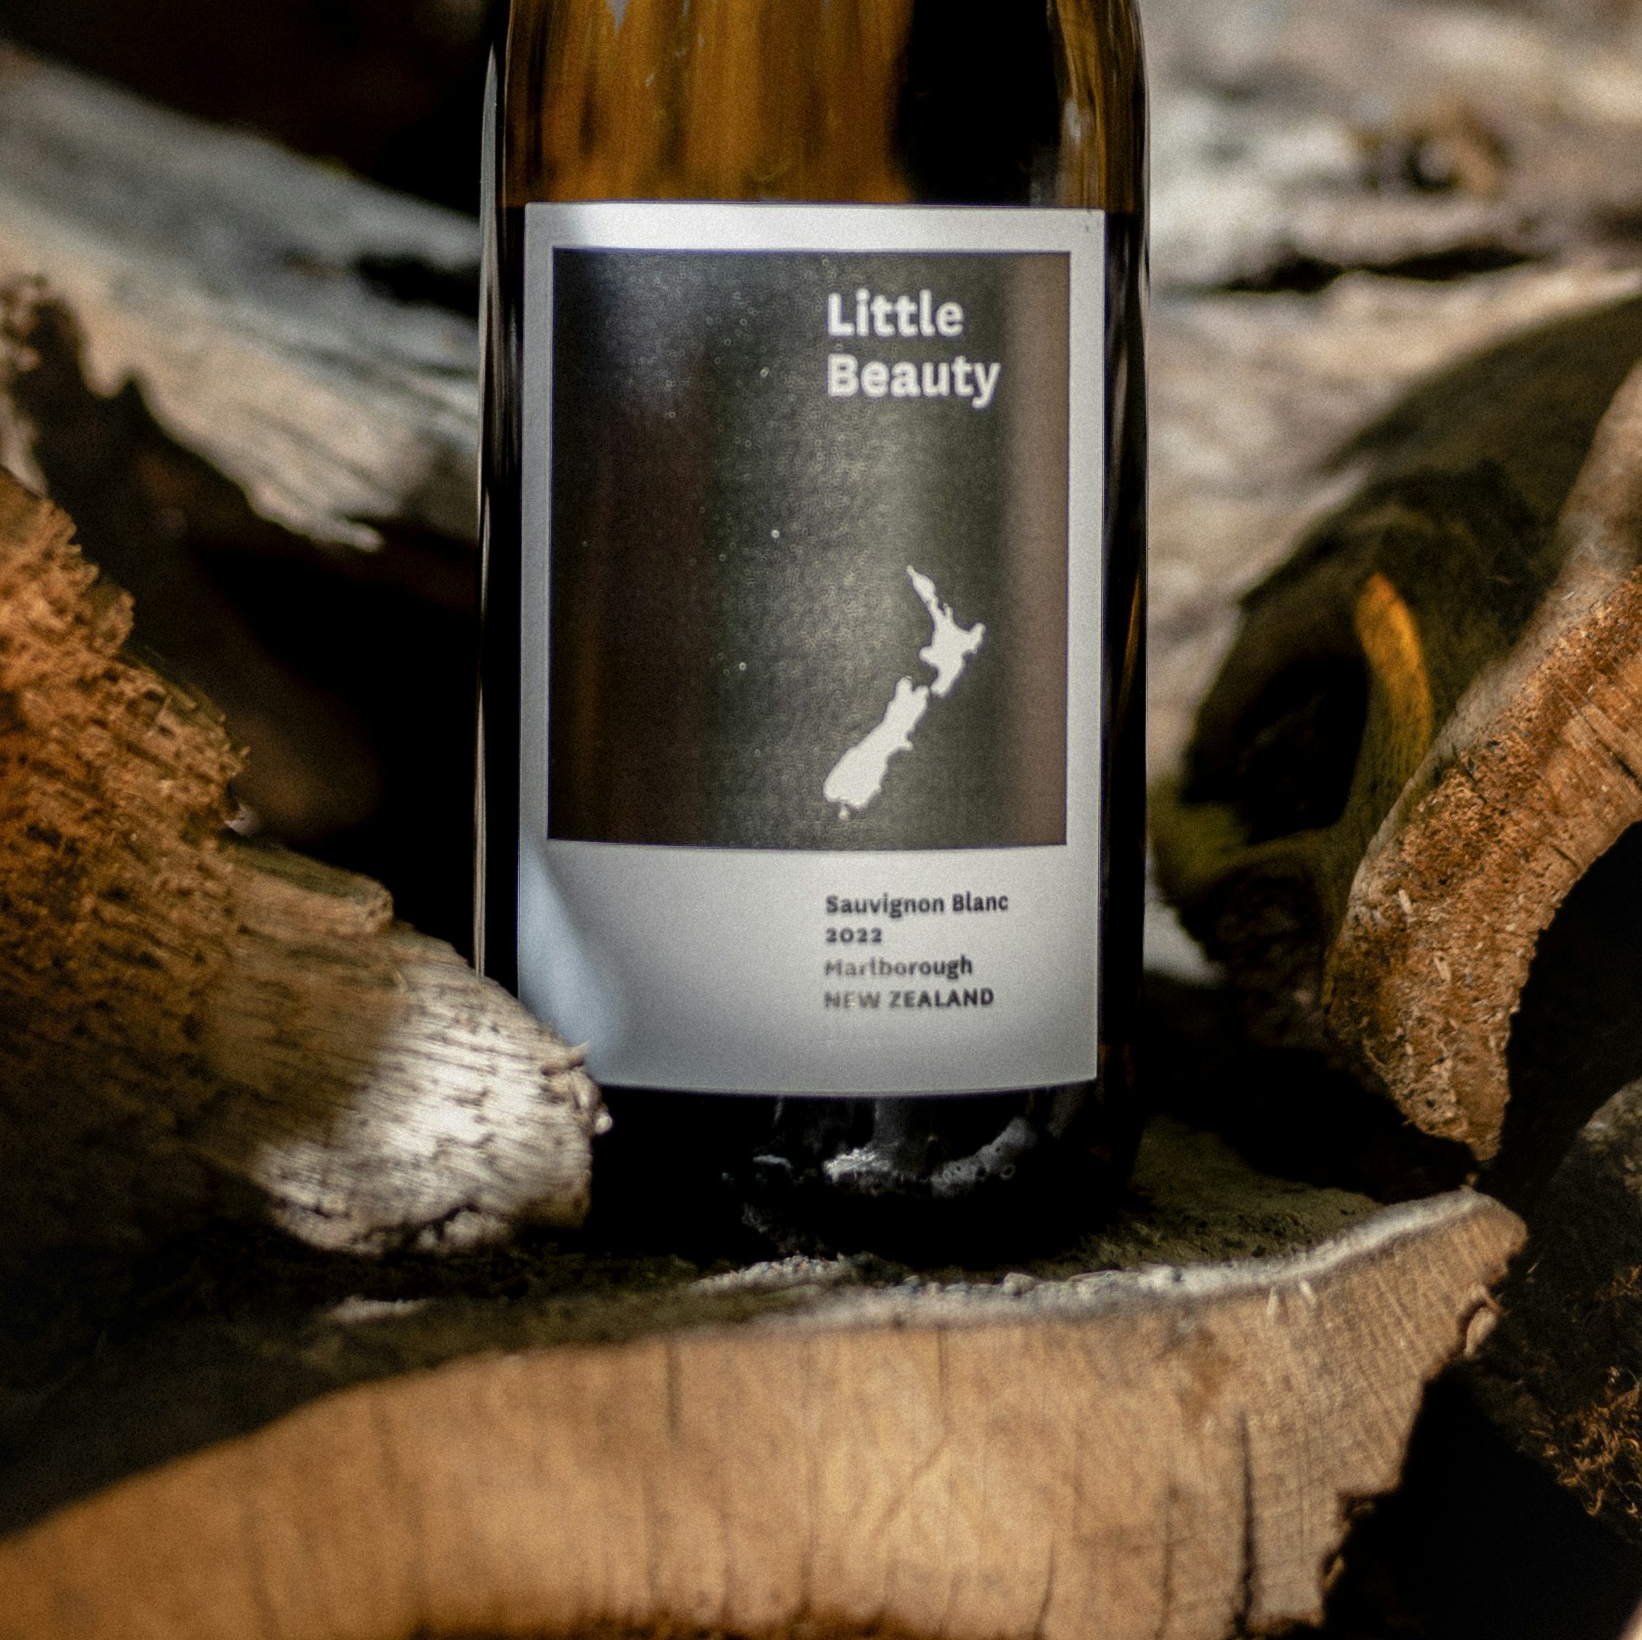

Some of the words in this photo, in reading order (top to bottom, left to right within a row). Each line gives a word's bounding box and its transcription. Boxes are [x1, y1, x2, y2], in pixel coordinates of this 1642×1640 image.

[827, 288, 965, 337] Little
[827, 353, 1002, 409] Beauty
[825, 893, 945, 919] Sauvignon
[952, 891, 1009, 912] Blanc
[825, 927, 883, 943] 2022
[824, 955, 973, 980] Marlborough
[824, 991, 881, 1009] NEW
[888, 987, 995, 1008] ZEALAND
